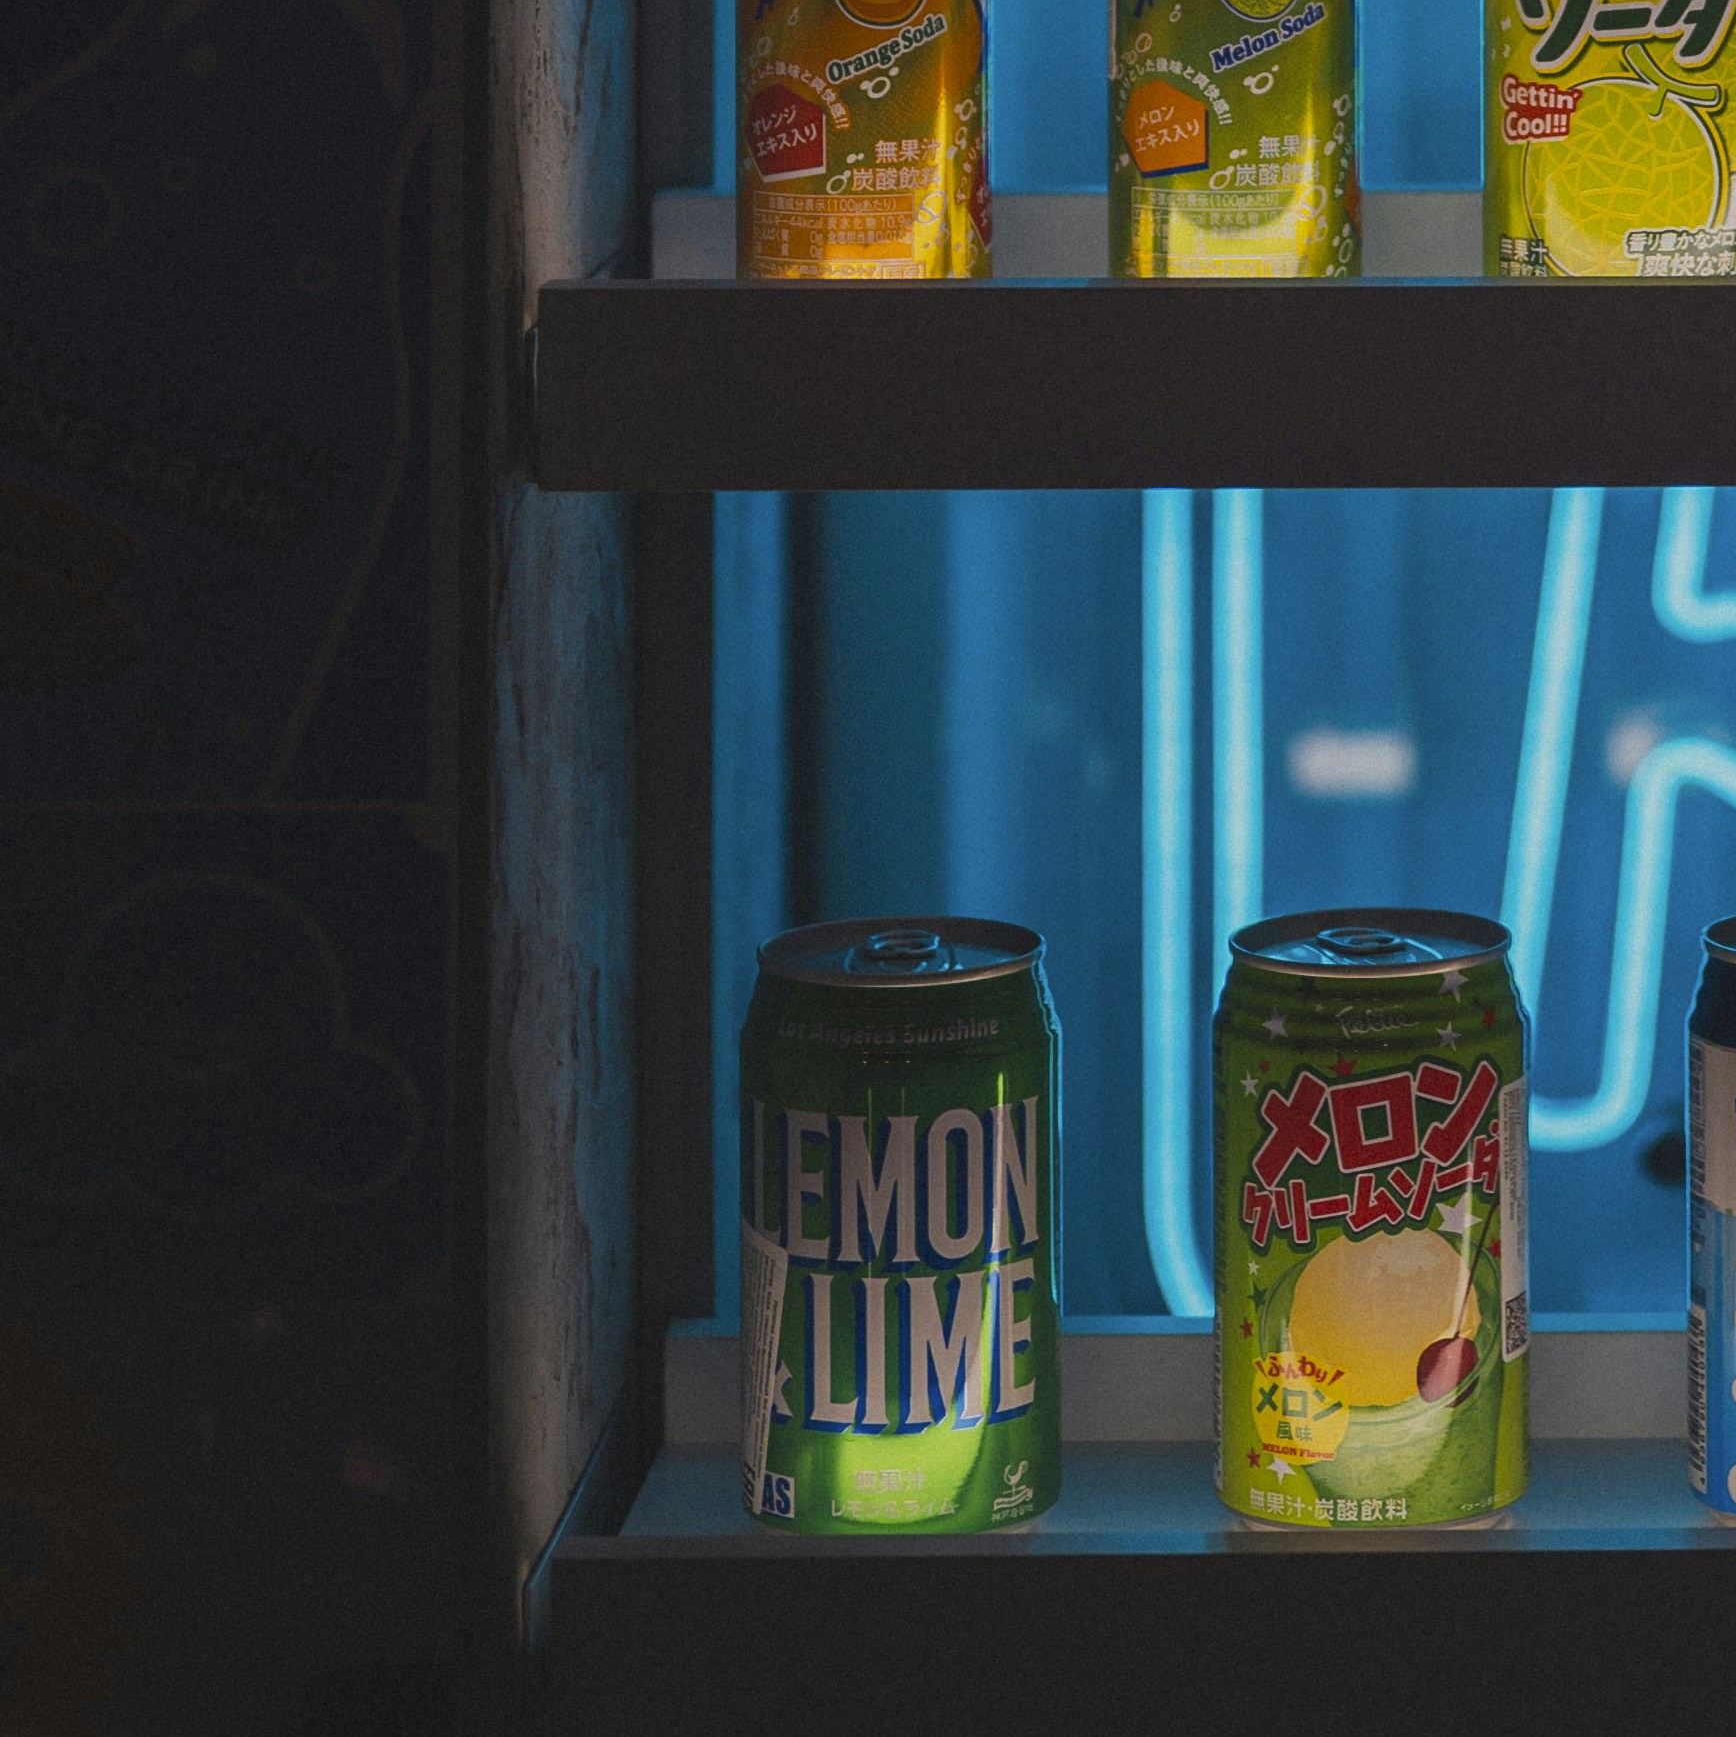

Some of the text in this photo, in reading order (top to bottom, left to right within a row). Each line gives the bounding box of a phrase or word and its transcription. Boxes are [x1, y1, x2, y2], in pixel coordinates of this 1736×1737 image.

[828, 15, 946, 82] Orange Soda
[1210, 2, 1326, 72] Melon Soda
[1503, 76, 1580, 109] Gettin'
[752, 104, 797, 137] オレンジ
[1138, 106, 1176, 130] メロン
[1505, 112, 1568, 137] Cool!!
[756, 123, 818, 157] エキス入り
[875, 138, 942, 164] 無果汁
[1135, 119, 1201, 153] エキス入り
[851, 166, 943, 191] 炭酸飲料
[903, 1017, 1000, 1045] Sunshine
[1252, 1060, 1498, 1189] メロン
[752, 1095, 1039, 1263] LEMON
[1242, 1118, 1500, 1246] クリームソーダ
[809, 1257, 1035, 1425] LIME
[1269, 1356, 1328, 1382] ふんわり
[1256, 1382, 1343, 1422] メロン
[1276, 1421, 1314, 1443] 風味
[1261, 1442, 1299, 1458] MELON
[761, 1476, 792, 1516] AS
